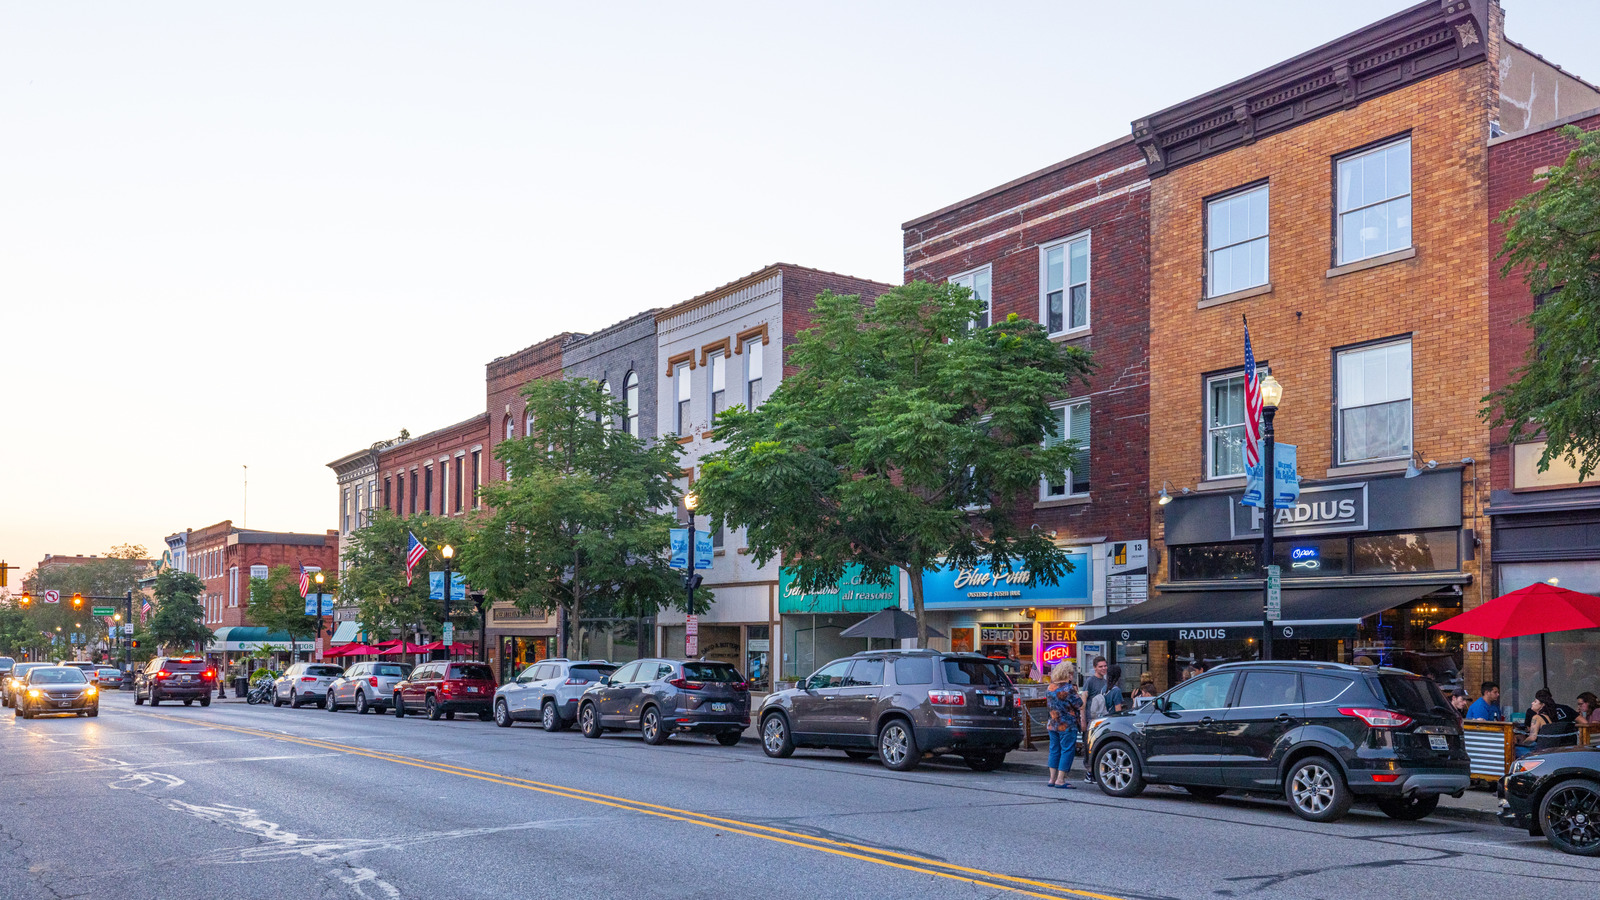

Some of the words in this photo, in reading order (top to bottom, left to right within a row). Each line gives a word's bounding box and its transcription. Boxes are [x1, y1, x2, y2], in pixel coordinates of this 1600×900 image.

[1292, 548, 1316, 559] Open
[953, 567, 991, 589] Blue
[992, 563, 1031, 587] Poin
[842, 590, 854, 600] all
[855, 592, 894, 600] reasons
[982, 630, 1030, 641] SEAFOOD
[1043, 630, 1077, 641] STEAK
[1179, 629, 1226, 640] RADIUS
[1043, 646, 1070, 662] OPEN
